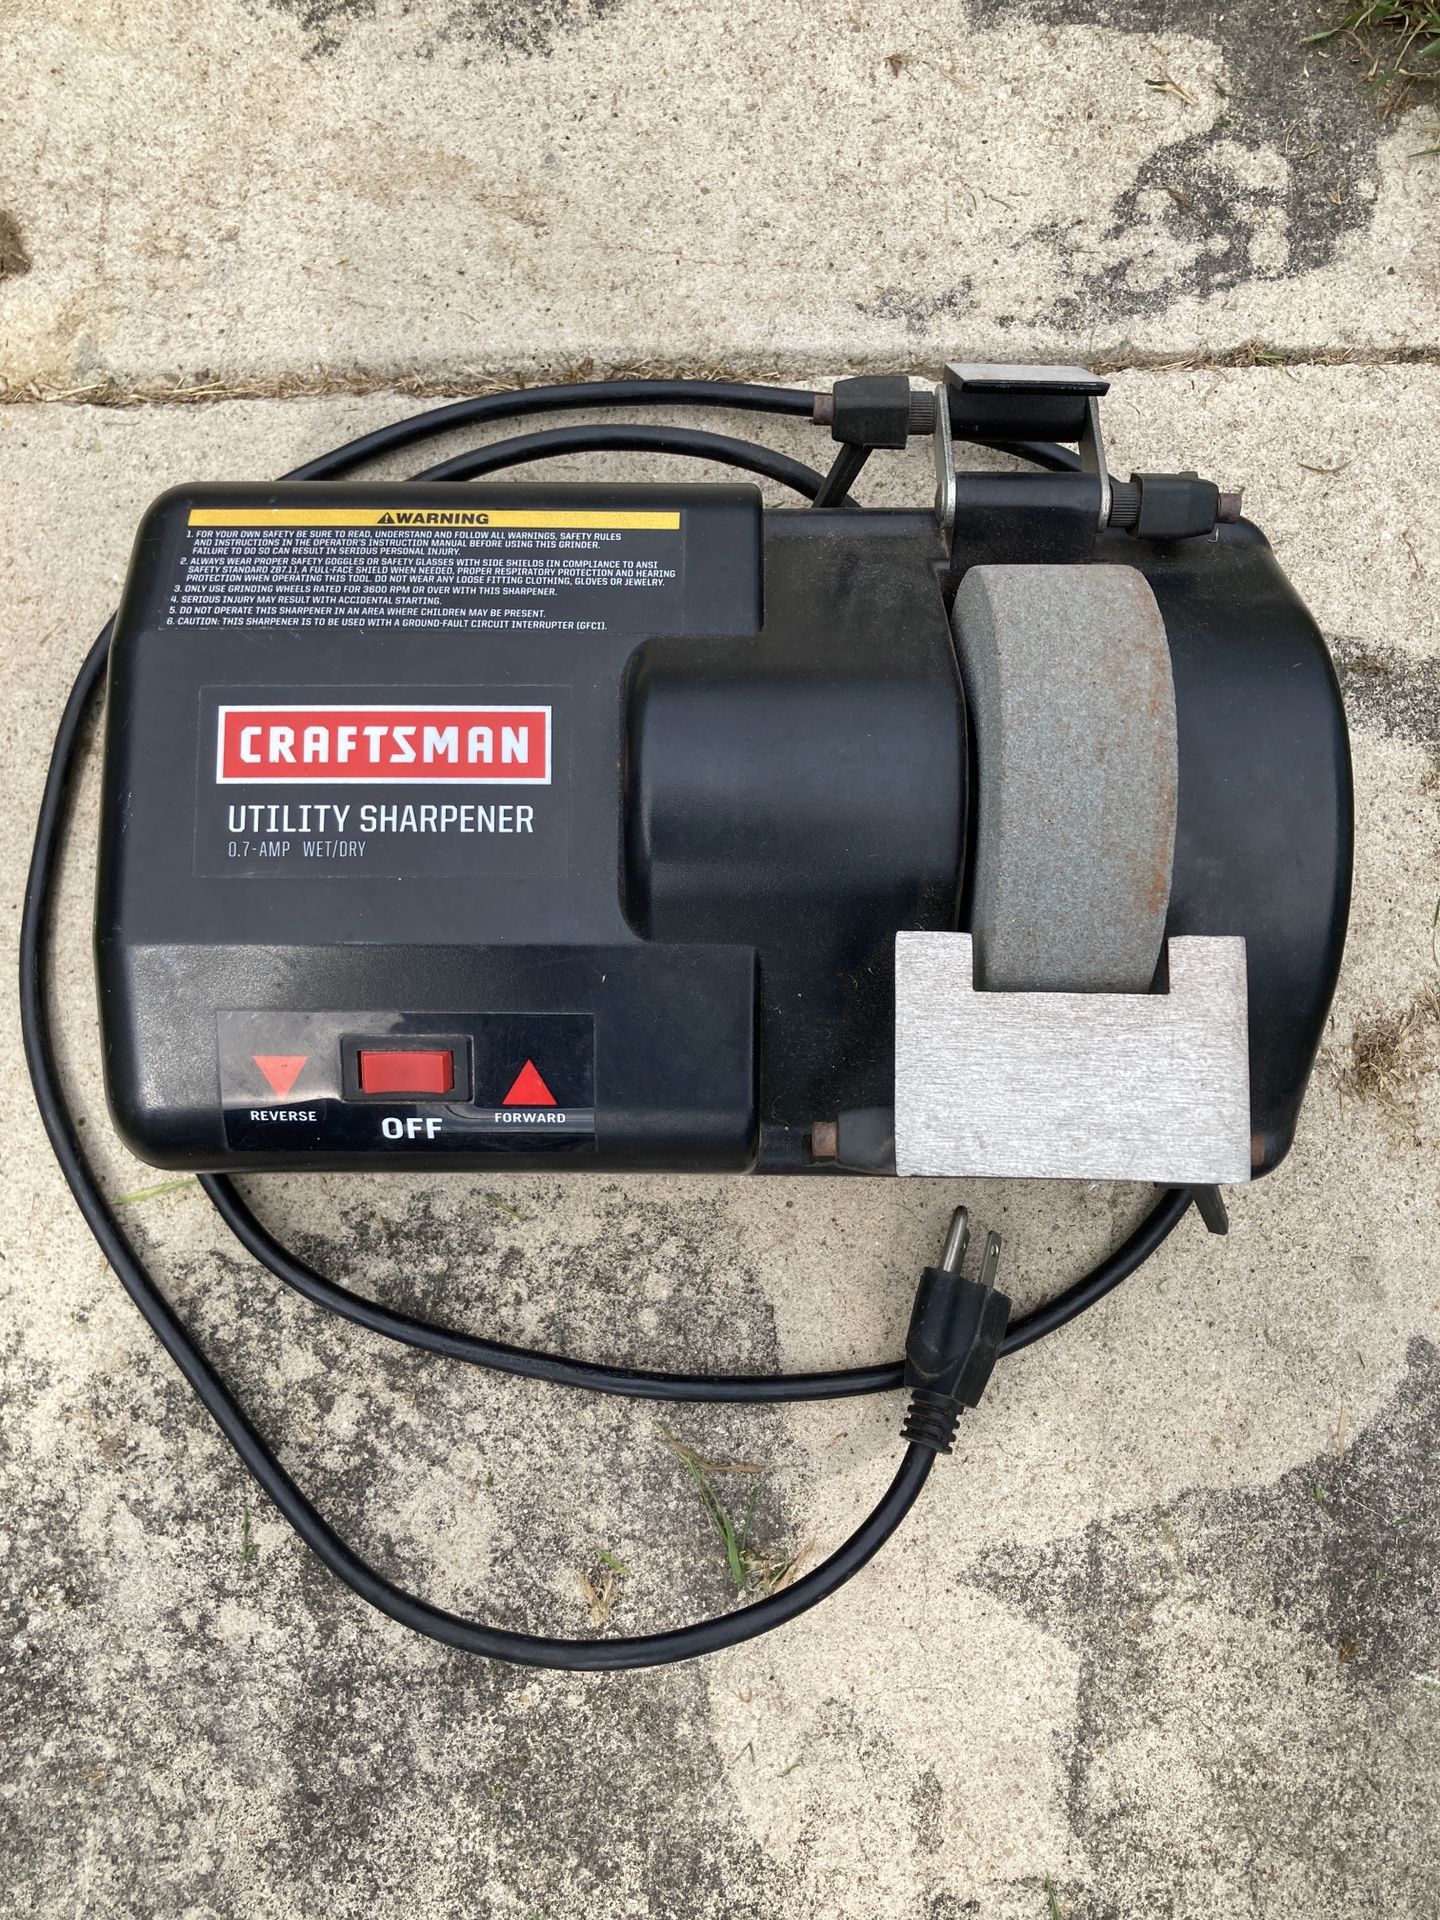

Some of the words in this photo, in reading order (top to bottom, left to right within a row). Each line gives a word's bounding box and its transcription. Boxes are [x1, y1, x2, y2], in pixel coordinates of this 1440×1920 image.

[396, 513, 489, 524] WARNING
[190, 558, 225, 566] ALWAYS
[227, 558, 252, 566] WEAR
[254, 558, 288, 566] PROPER
[291, 558, 322, 566] SAFETY
[325, 558, 364, 567] GOGGLES
[381, 559, 412, 567] SAFETY
[416, 559, 454, 567] GLASSES
[506, 560, 544, 568] SHIELDS
[563, 560, 619, 568] COMPLIANCE
[222, 566, 268, 574] STANDARD
[309, 567, 354, 575] FULL-FACE
[355, 567, 388, 575] SHIELD
[390, 567, 416, 575] WHEN
[419, 568, 455, 576] NEEDED,
[457, 568, 492, 576] PROPER
[494, 568, 555, 577] RESPIRATORY
[558, 569, 613, 577] PROTECTION
[616, 569, 633, 577] AND
[636, 570, 675, 578] HEARING
[186, 574, 242, 583] PROTECTION
[244, 575, 270, 583] WHEN
[272, 575, 322, 583] OPERATING
[325, 576, 346, 584] THIS
[349, 576, 372, 584] TOOL.
[375, 576, 387, 584] DO
[389, 576, 406, 584] NOT
[409, 576, 434, 584] WEAR
[436, 577, 453, 585] ANY
[456, 577, 484, 585] LOOSE
[487, 577, 523, 585] FITTING
[525, 577, 573, 586] CLOTHING,
[575, 578, 608, 586] GLOVES
[610, 578, 622, 586] OR
[625, 578, 665, 586] JEWELRY.
[174, 585, 182, 593] 3.
[184, 585, 207, 593] ONLY
[208, 585, 226, 593] USE
[227, 585, 274, 594] GRINDING
[275, 586, 311, 594] WHEELS
[313, 586, 341, 594] RATED
[343, 586, 361, 594] FOR
[363, 586, 387, 594] 3600
[390, 587, 410, 595] RPM
[412, 587, 425, 595] OR
[427, 587, 450, 595] OVER
[452, 587, 476, 595] WITH
[479, 587, 500, 595] THIS
[502, 588, 558, 596] SHARPENER.
[180, 596, 221, 604] SERIOUS
[222, 596, 255, 604] INJURY
[256, 596, 276, 604] MAY
[278, 596, 310, 604] RESULT
[312, 596, 337, 604] WITH
[338, 596, 393, 605] ACCIDENTAL
[395, 596, 442, 605] STARTING.
[169, 606, 177, 614] 5.
[180, 606, 192, 614] DO
[194, 606, 211, 615] NOT
[214, 607, 253, 615] OPERATE
[256, 607, 277, 615] THIS
[279, 607, 332, 616] SHARPENER
[334, 608, 345, 616] IN
[347, 608, 359, 616] AN
[362, 608, 385, 616] AREA
[387, 608, 418, 617] WHERE
[421, 608, 466, 617] CHILDREN
[468, 609, 488, 617] MAY
[490, 609, 501, 617] BE
[504, 609, 546, 618] PRESENT.
[166, 617, 175, 626] 6.
[177, 617, 220, 626] CAUTION:
[223, 618, 244, 627] THIS
[246, 618, 299, 627] SHARPENER
[302, 618, 311, 627] IS
[315, 618, 325, 627] TO
[328, 619, 338, 628] BE
[342, 619, 365, 628] USED
[367, 619, 391, 628] WITH
[394, 619, 400, 628] A
[403, 619, 467, 629] GROUND-FAULT
[471, 620, 508, 629] CIRCUIT
[512, 620, 573, 630] INTERRUPTER
[577, 621, 607, 630] (GFCI).
[240, 726, 528, 764] CRAFTSMAN
[228, 805, 350, 833] UTILITY
[360, 805, 534, 834] SHARPENER
[228, 841, 290, 858] 0.7-AMP
[303, 841, 366, 858] WET/DRY
[250, 1110, 318, 1122] REVERSE
[494, 1112, 566, 1124] FORWARD
[382, 1117, 443, 1140] OFF
